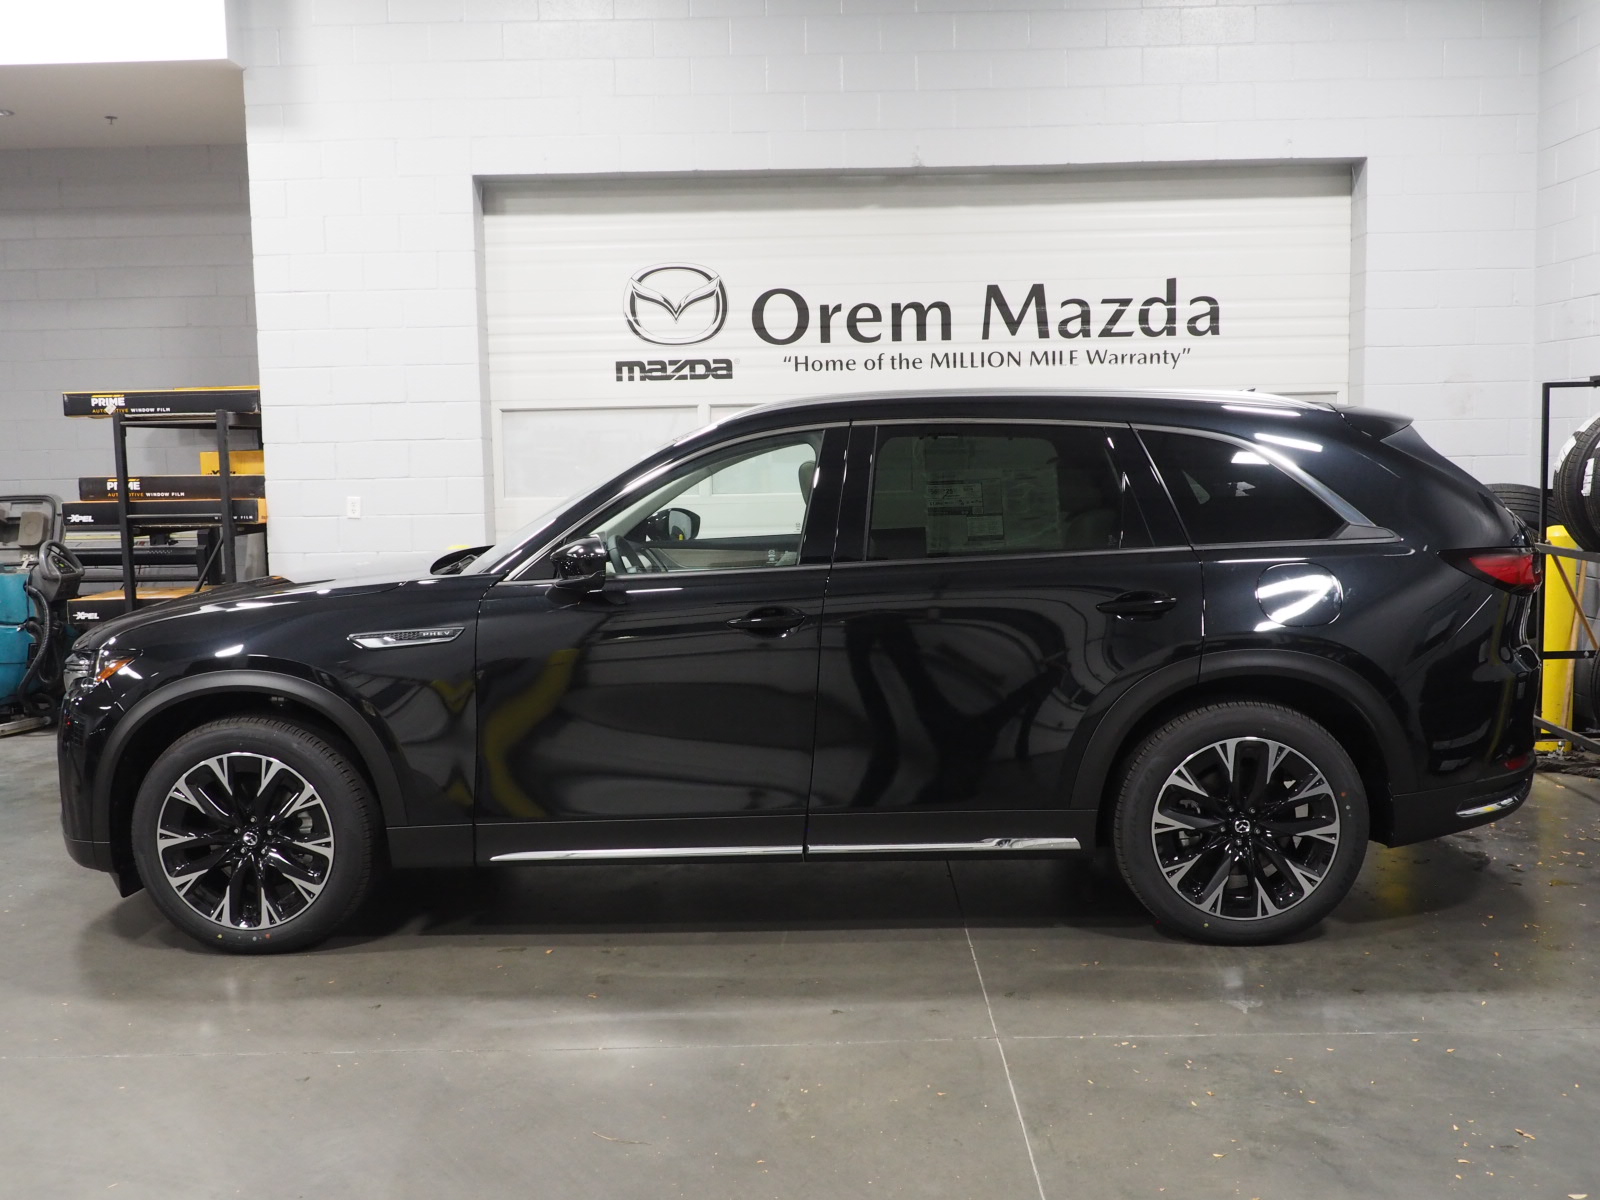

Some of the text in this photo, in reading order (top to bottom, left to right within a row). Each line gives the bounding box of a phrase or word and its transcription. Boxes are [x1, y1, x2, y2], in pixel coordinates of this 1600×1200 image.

[751, 277, 1221, 345] Orem Mazda
[783, 347, 1191, 372] “Home of the MILLION MILE Warranty”
[90, 397, 126, 407] PRIME
[68, 514, 94, 523] XPEL
[74, 611, 100, 620] XPEL
